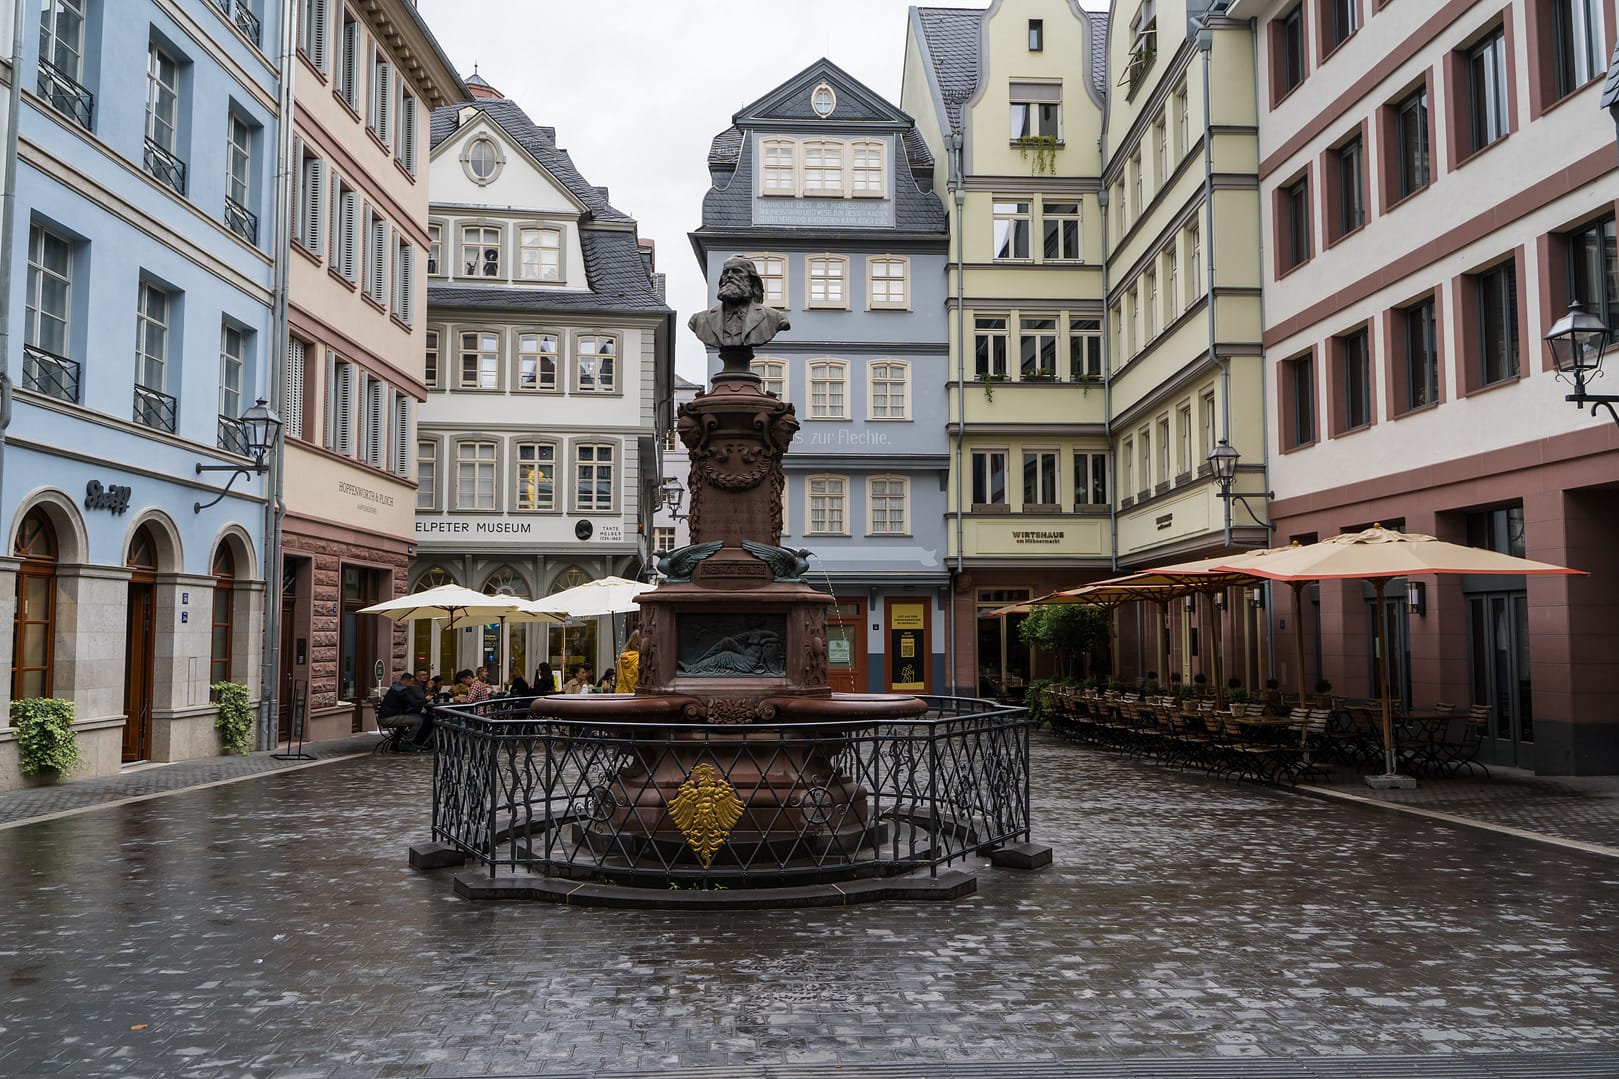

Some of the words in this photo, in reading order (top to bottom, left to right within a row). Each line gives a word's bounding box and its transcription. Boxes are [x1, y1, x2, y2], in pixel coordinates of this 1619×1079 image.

[811, 431, 834, 445] zur
[838, 428, 891, 445] Flechte.
[476, 522, 531, 533] MUSEUM
[1012, 531, 1064, 539] WIRTSHAUS
